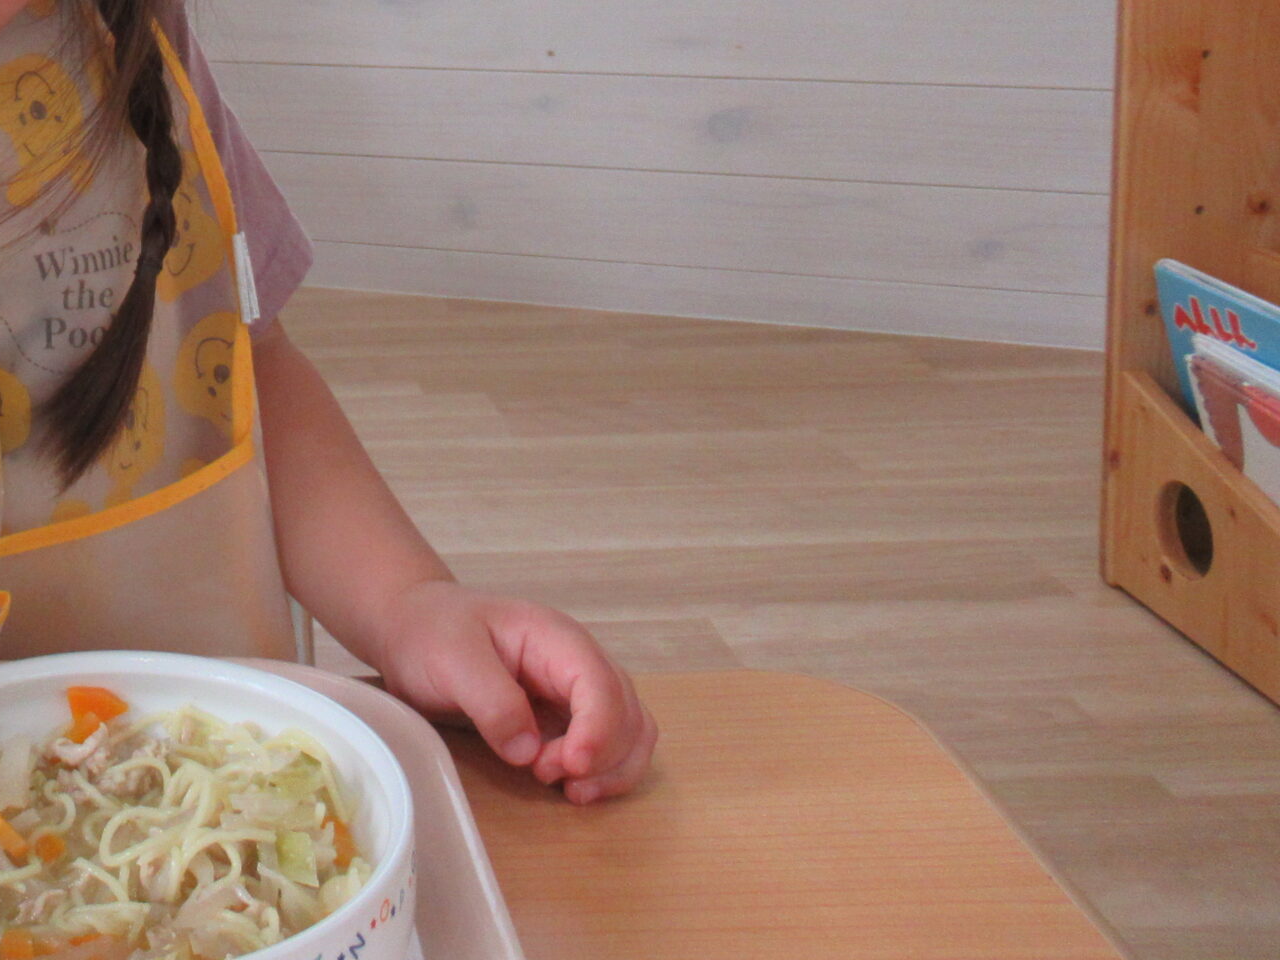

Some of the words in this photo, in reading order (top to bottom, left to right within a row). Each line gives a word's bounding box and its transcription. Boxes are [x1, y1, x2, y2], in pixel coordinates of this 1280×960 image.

[34, 235, 135, 281] Winnie
[62, 279, 115, 311] the
[43, 317, 110, 351] Poo
